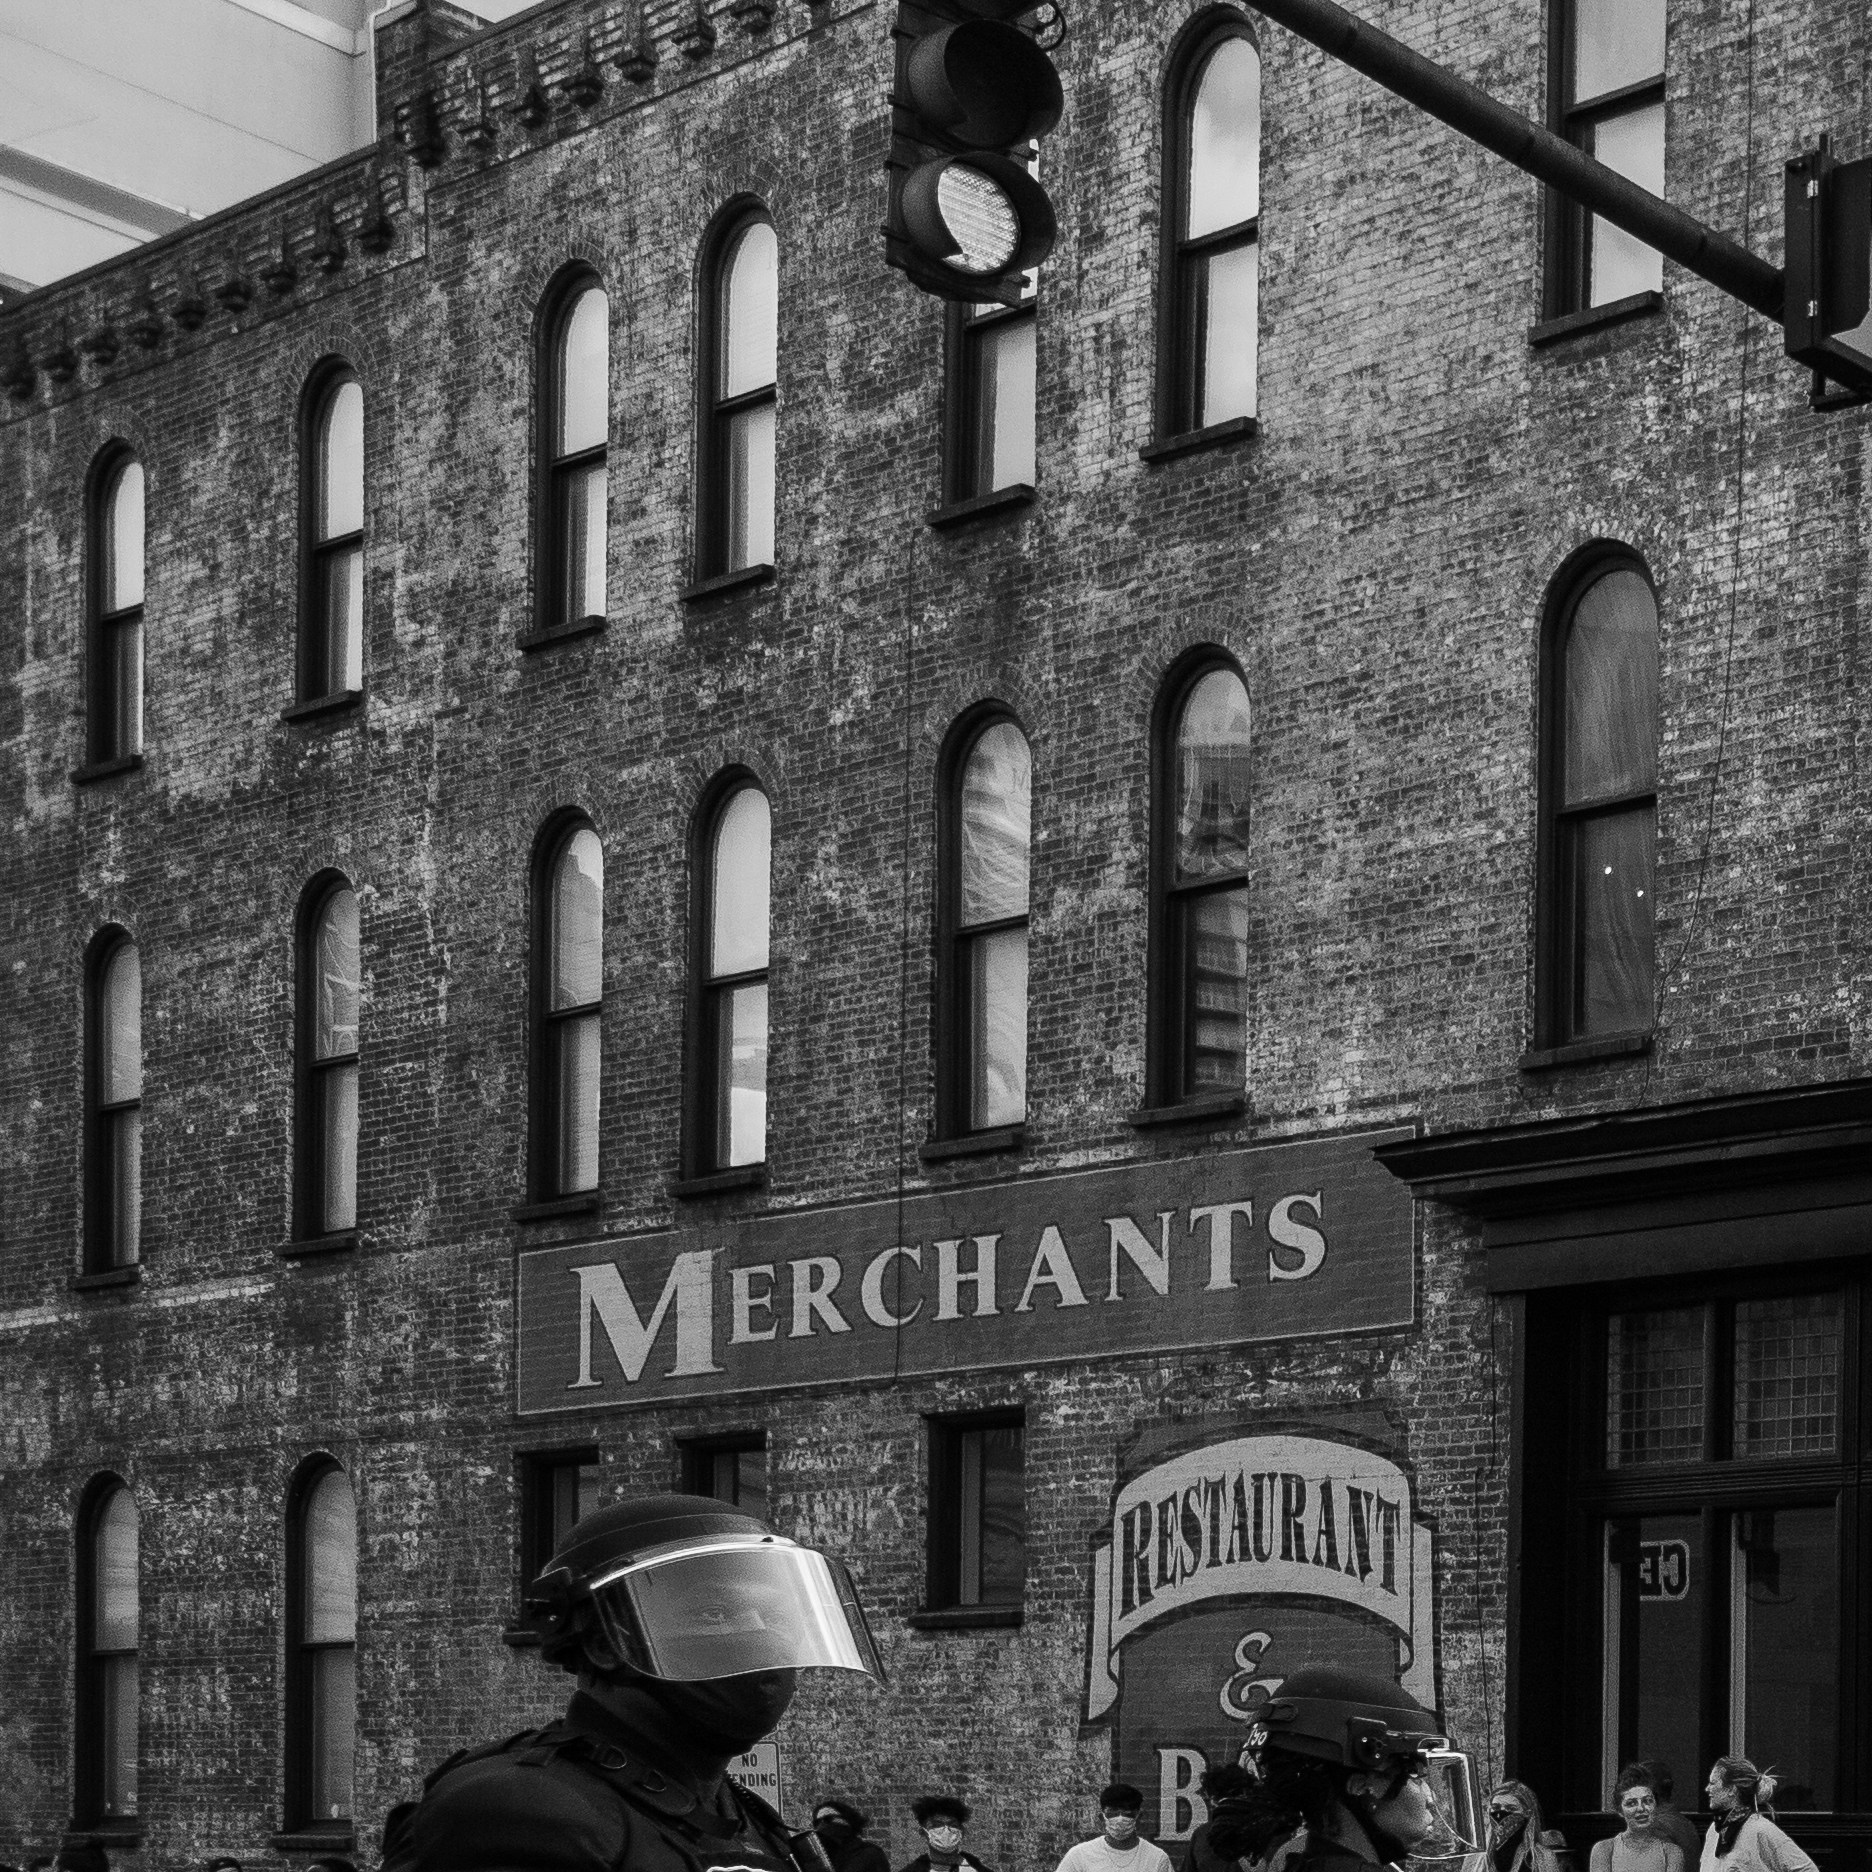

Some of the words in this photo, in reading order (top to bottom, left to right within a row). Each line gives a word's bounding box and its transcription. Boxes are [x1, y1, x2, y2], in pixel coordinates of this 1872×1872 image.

[566, 1189, 1327, 1391] MERCHANTS
[1118, 1470, 1402, 1618] RESTAURANT
[1219, 1631, 1285, 1720] &
[741, 1754, 758, 1767] NO
[1154, 1748, 1209, 1841] B
